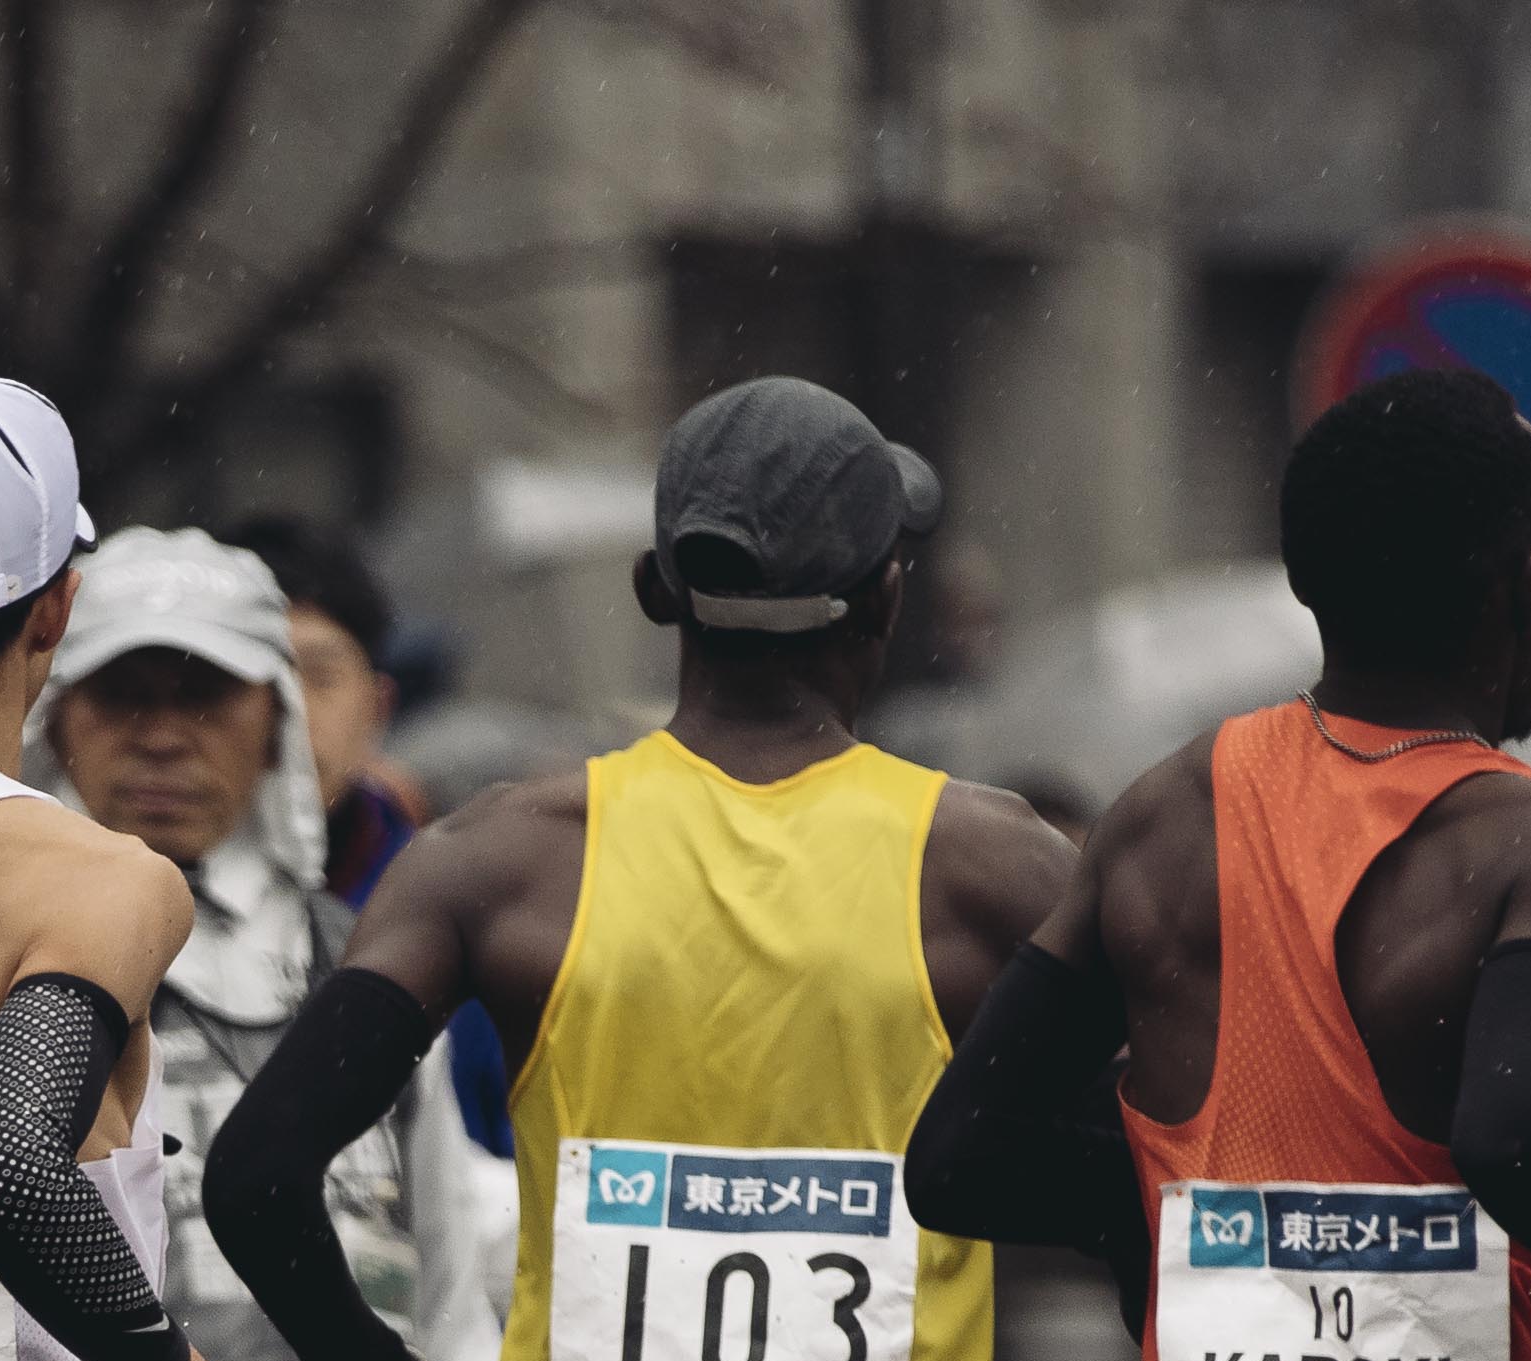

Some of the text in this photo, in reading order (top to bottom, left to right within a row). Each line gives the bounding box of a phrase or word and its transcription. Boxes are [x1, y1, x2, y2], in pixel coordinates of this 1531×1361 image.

[684, 1174, 878, 1216] 東京メトロ
[1280, 1211, 1459, 1252] 東京メトロ
[1309, 1285, 1353, 1342] 10
